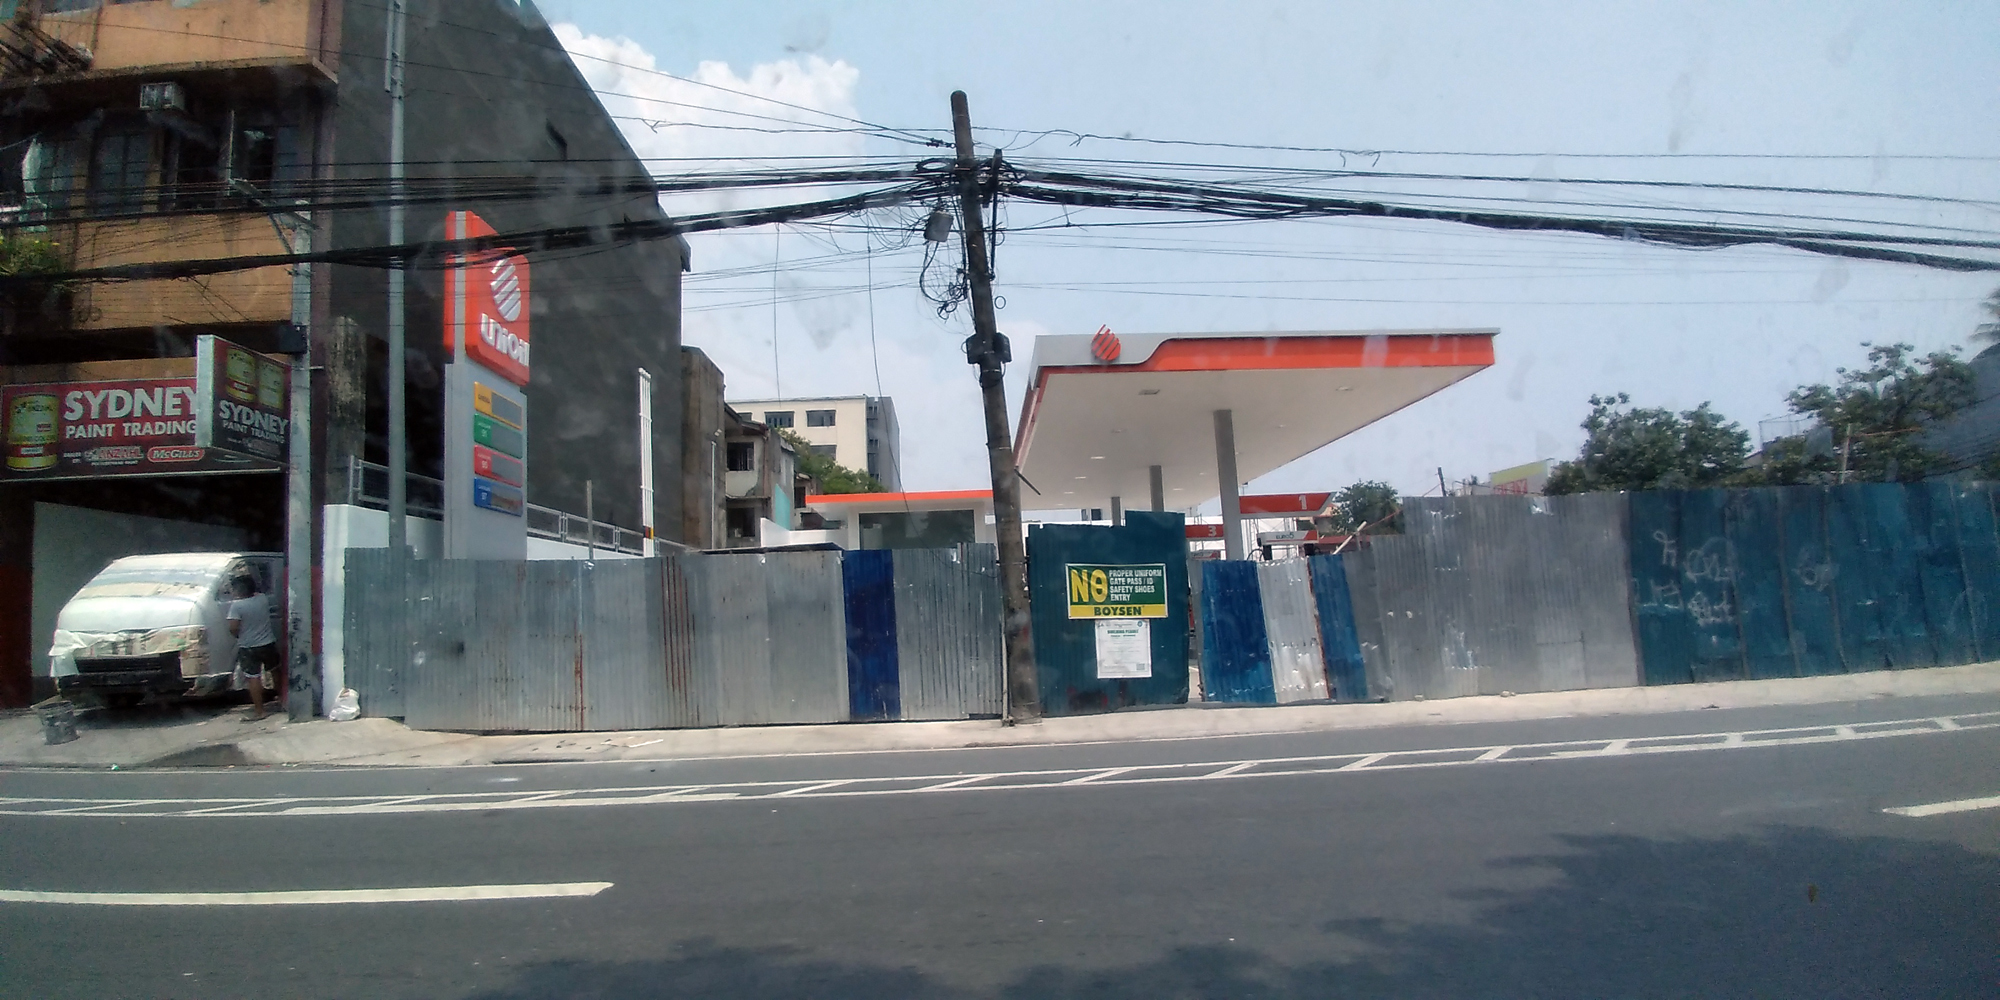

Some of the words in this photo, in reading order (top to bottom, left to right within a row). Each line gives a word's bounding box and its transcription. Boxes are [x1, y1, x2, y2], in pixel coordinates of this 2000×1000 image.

[64, 386, 197, 420] SYDNEY
[219, 399, 289, 435] SYDNEY
[65, 423, 116, 439] PAINT
[122, 420, 197, 436] TRADING
[222, 419, 248, 434] PAINT
[251, 427, 285, 444] TRADING
[1298, 494, 1308, 510] 1
[1207, 525, 1217, 537] 3
[1134, 569, 1162, 577] UNIFORM
[1070, 569, 1108, 603] NO
[1126, 577, 1142, 585] PASS
[1146, 577, 1154, 585] ID
[1109, 585, 1133, 593] SAFETY
[1134, 585, 1155, 593] SHOES
[1110, 594, 1131, 602] ENTRY
[1094, 606, 1142, 616] BOYSEN
